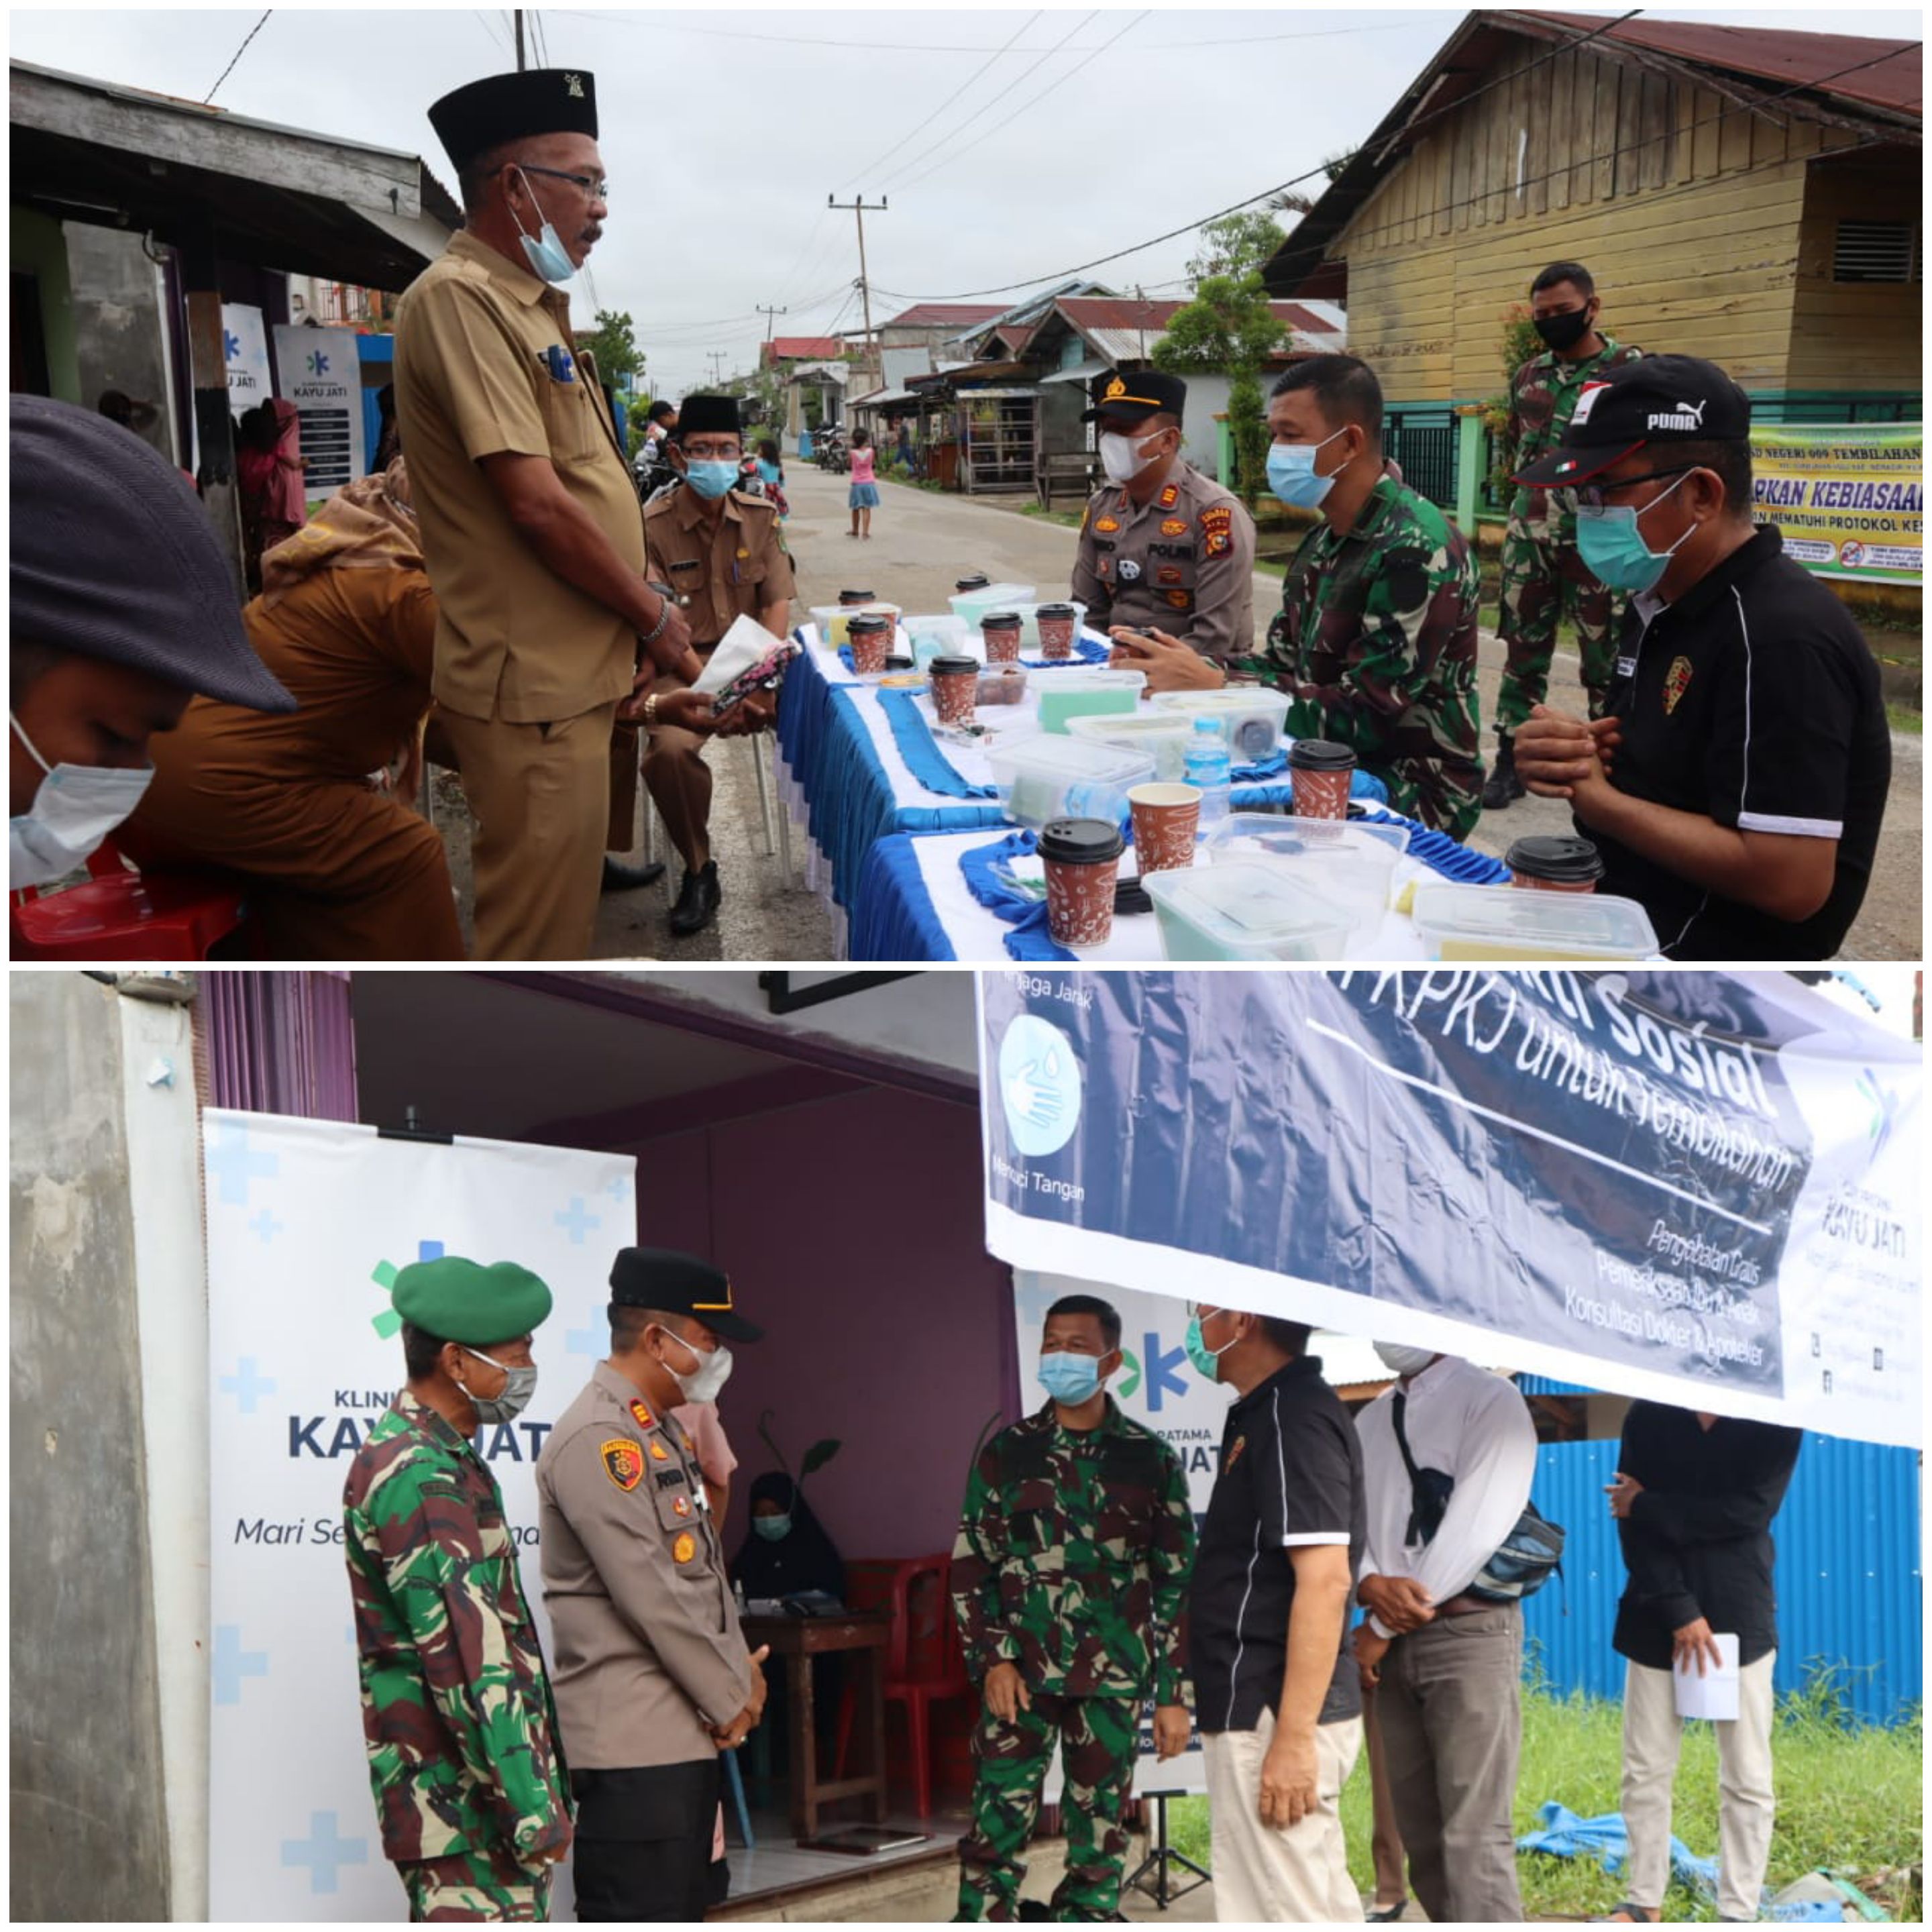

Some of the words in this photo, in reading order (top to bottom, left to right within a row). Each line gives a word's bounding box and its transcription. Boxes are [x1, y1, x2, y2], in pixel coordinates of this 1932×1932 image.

[293, 387, 323, 398] KAYU
[326, 386, 347, 397] JATI
[1648, 413, 1698, 430] PUMA
[1833, 448, 1921, 460] TEMBILAHAN
[1770, 512, 1825, 527] MEMATUHI
[1829, 516, 1898, 531] PROTOKOL
[1596, 973, 1779, 1118] Sosial
[1032, 1171, 1085, 1201] Tangan
[234, 1519, 305, 1545] Mari
